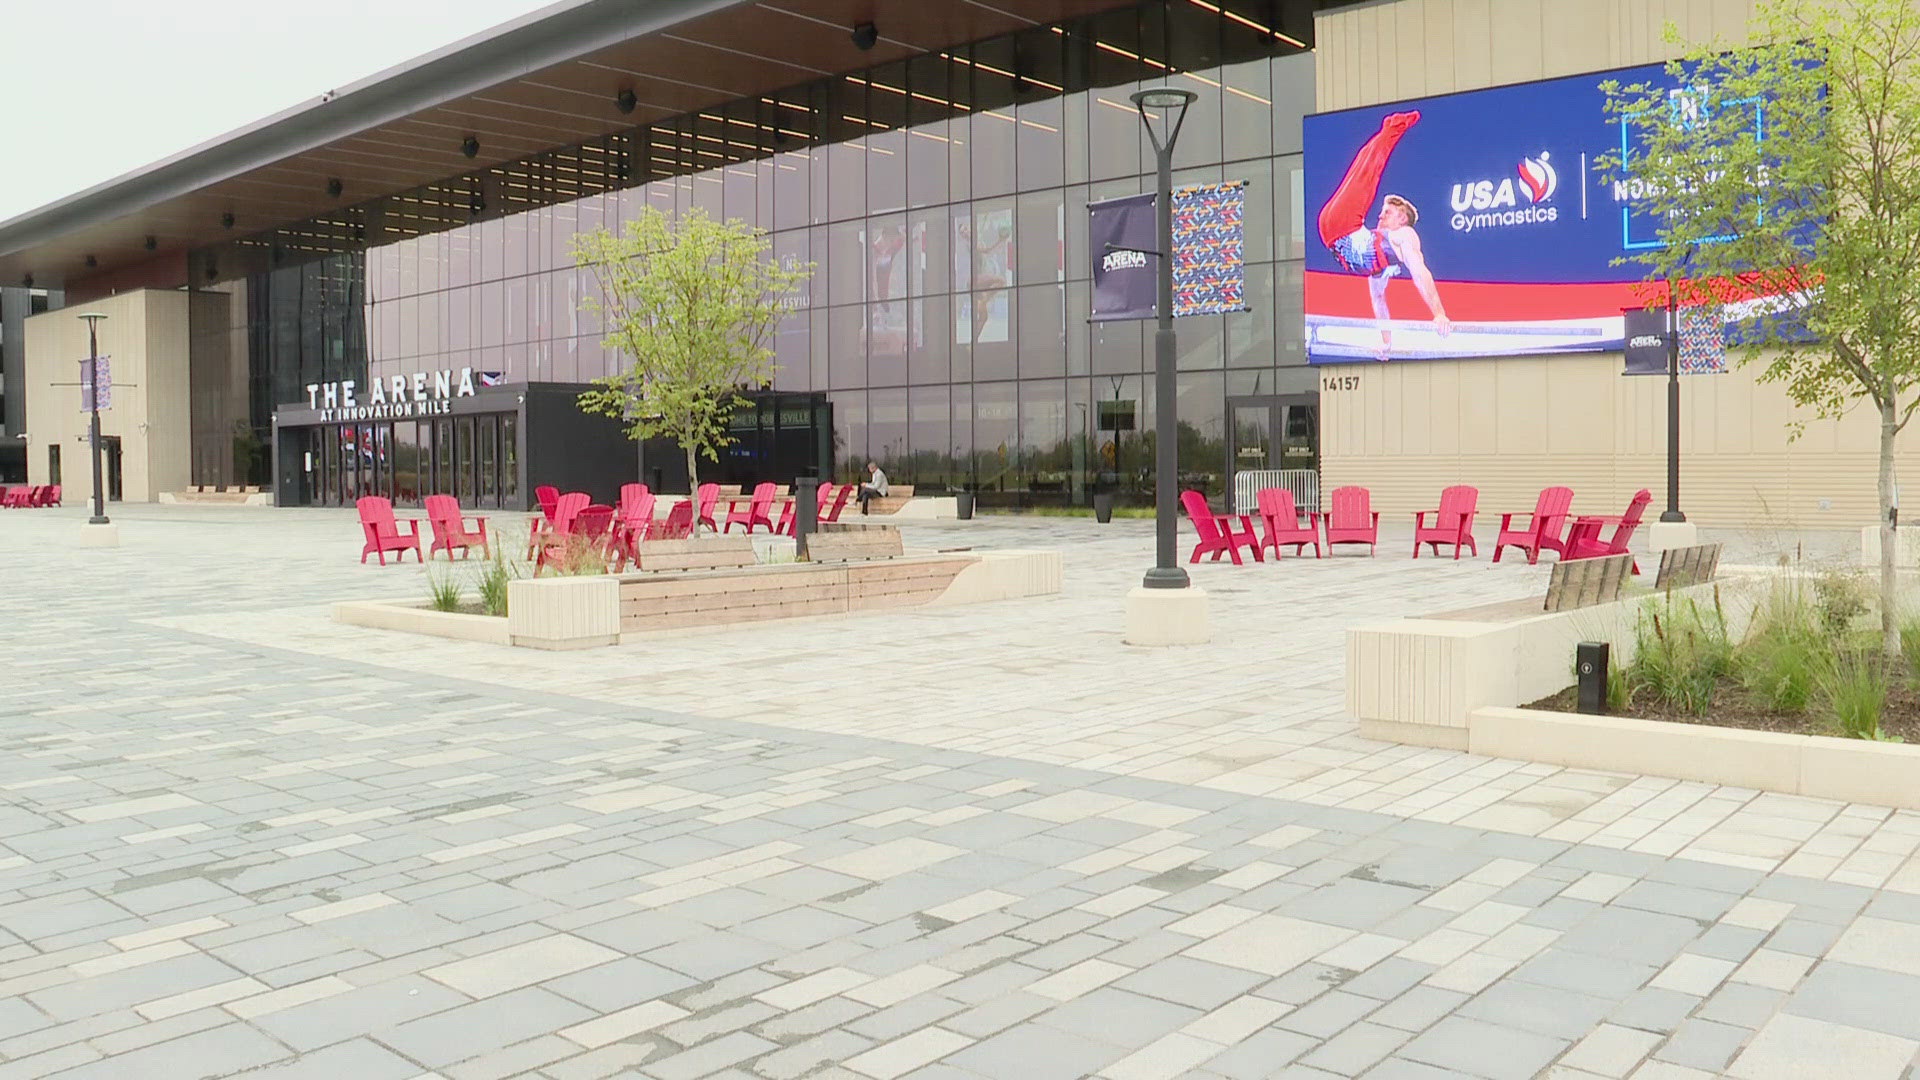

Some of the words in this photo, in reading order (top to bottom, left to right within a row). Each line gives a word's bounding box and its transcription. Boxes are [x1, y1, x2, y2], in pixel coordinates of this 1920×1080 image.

[1451, 178, 1516, 212] USA
[1451, 206, 1558, 233] Gymnastics
[1102, 251, 1147, 270] ARENA
[307, 380, 356, 410] THE
[370, 367, 475, 405] ARENA
[1322, 377, 1360, 391] 14157
[320, 409, 334, 423] AT
[338, 403, 412, 421] INNOVATION
[418, 400, 450, 415] MILE
